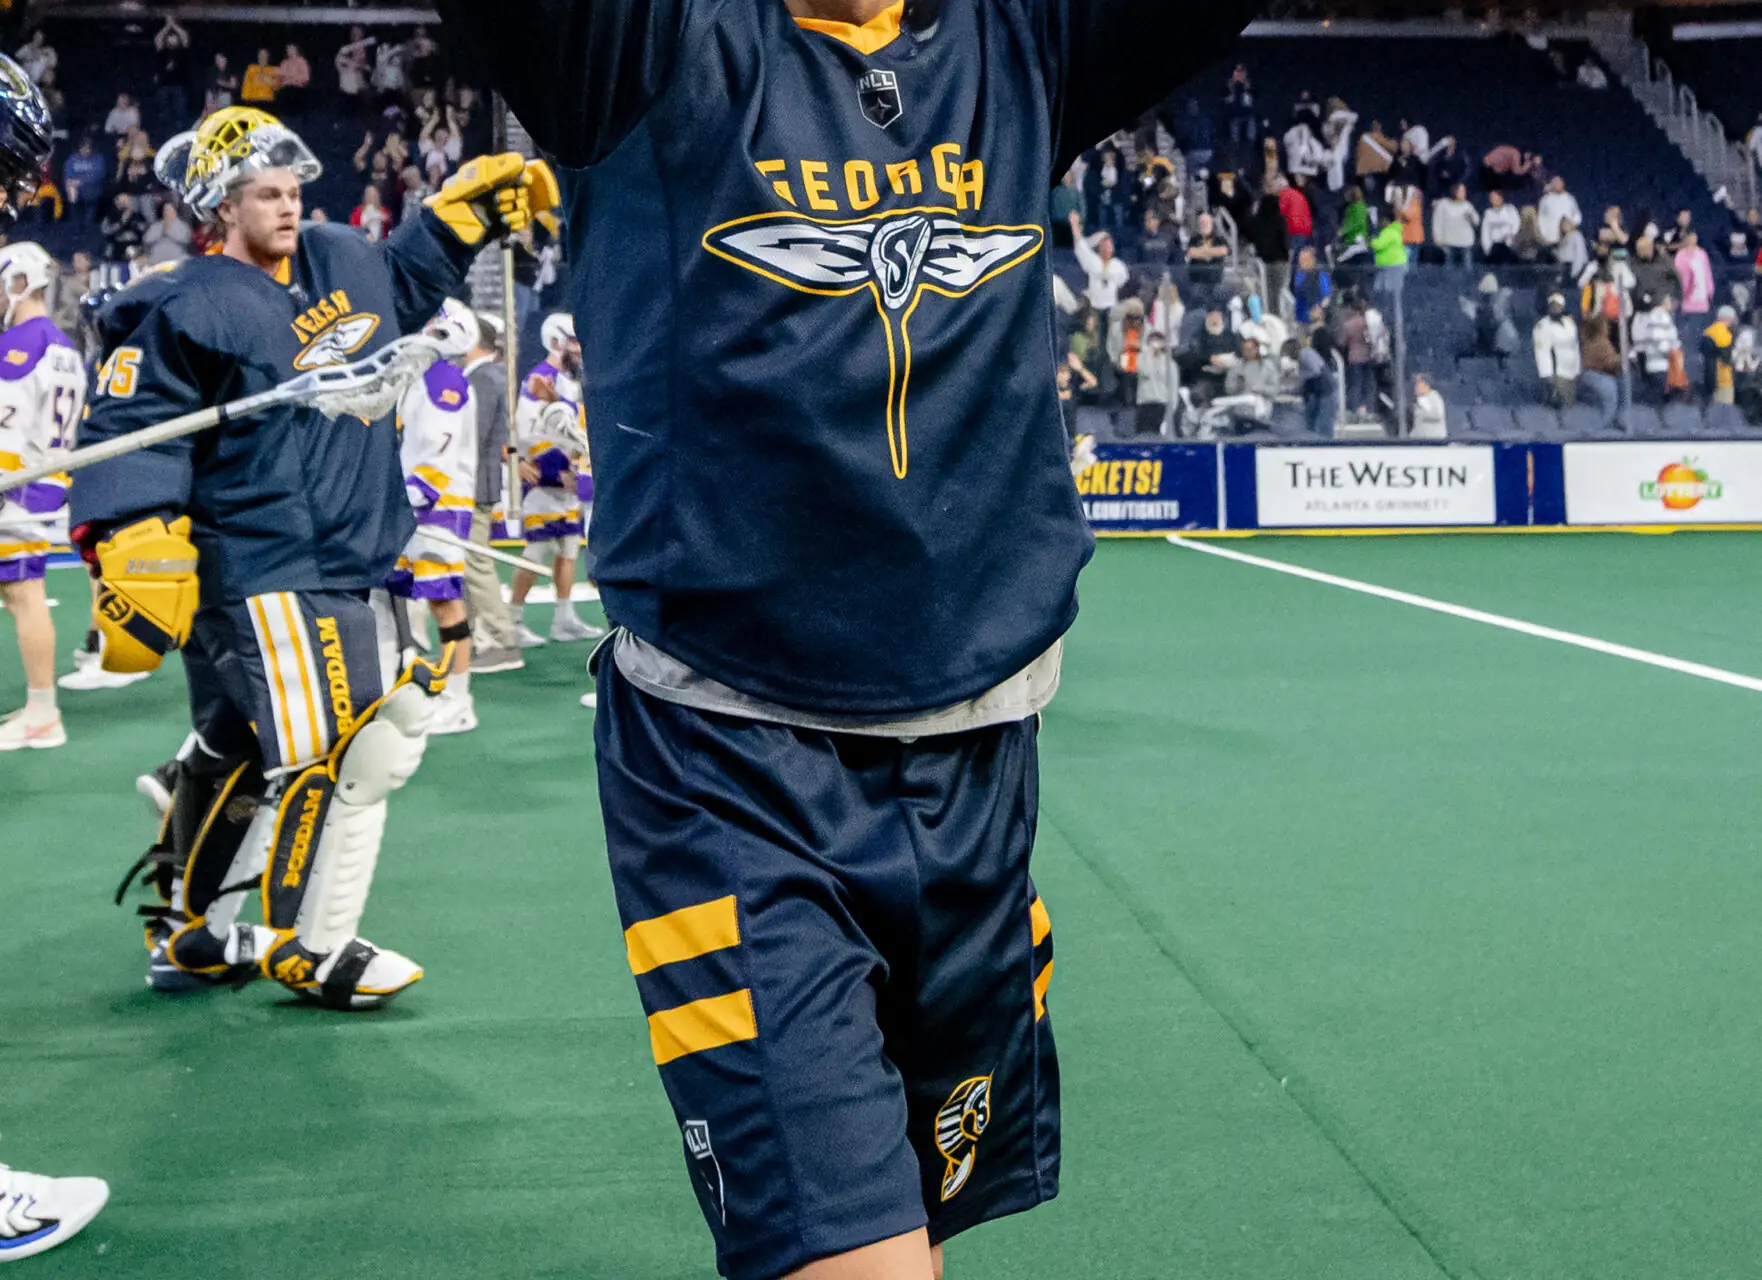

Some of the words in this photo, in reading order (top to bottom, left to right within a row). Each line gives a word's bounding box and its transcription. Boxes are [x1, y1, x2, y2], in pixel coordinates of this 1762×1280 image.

[859, 73, 893, 89] NLL
[754, 142, 984, 211] GEORGA
[439, 432, 452, 453] 7
[1075, 460, 1163, 495] CKETS!
